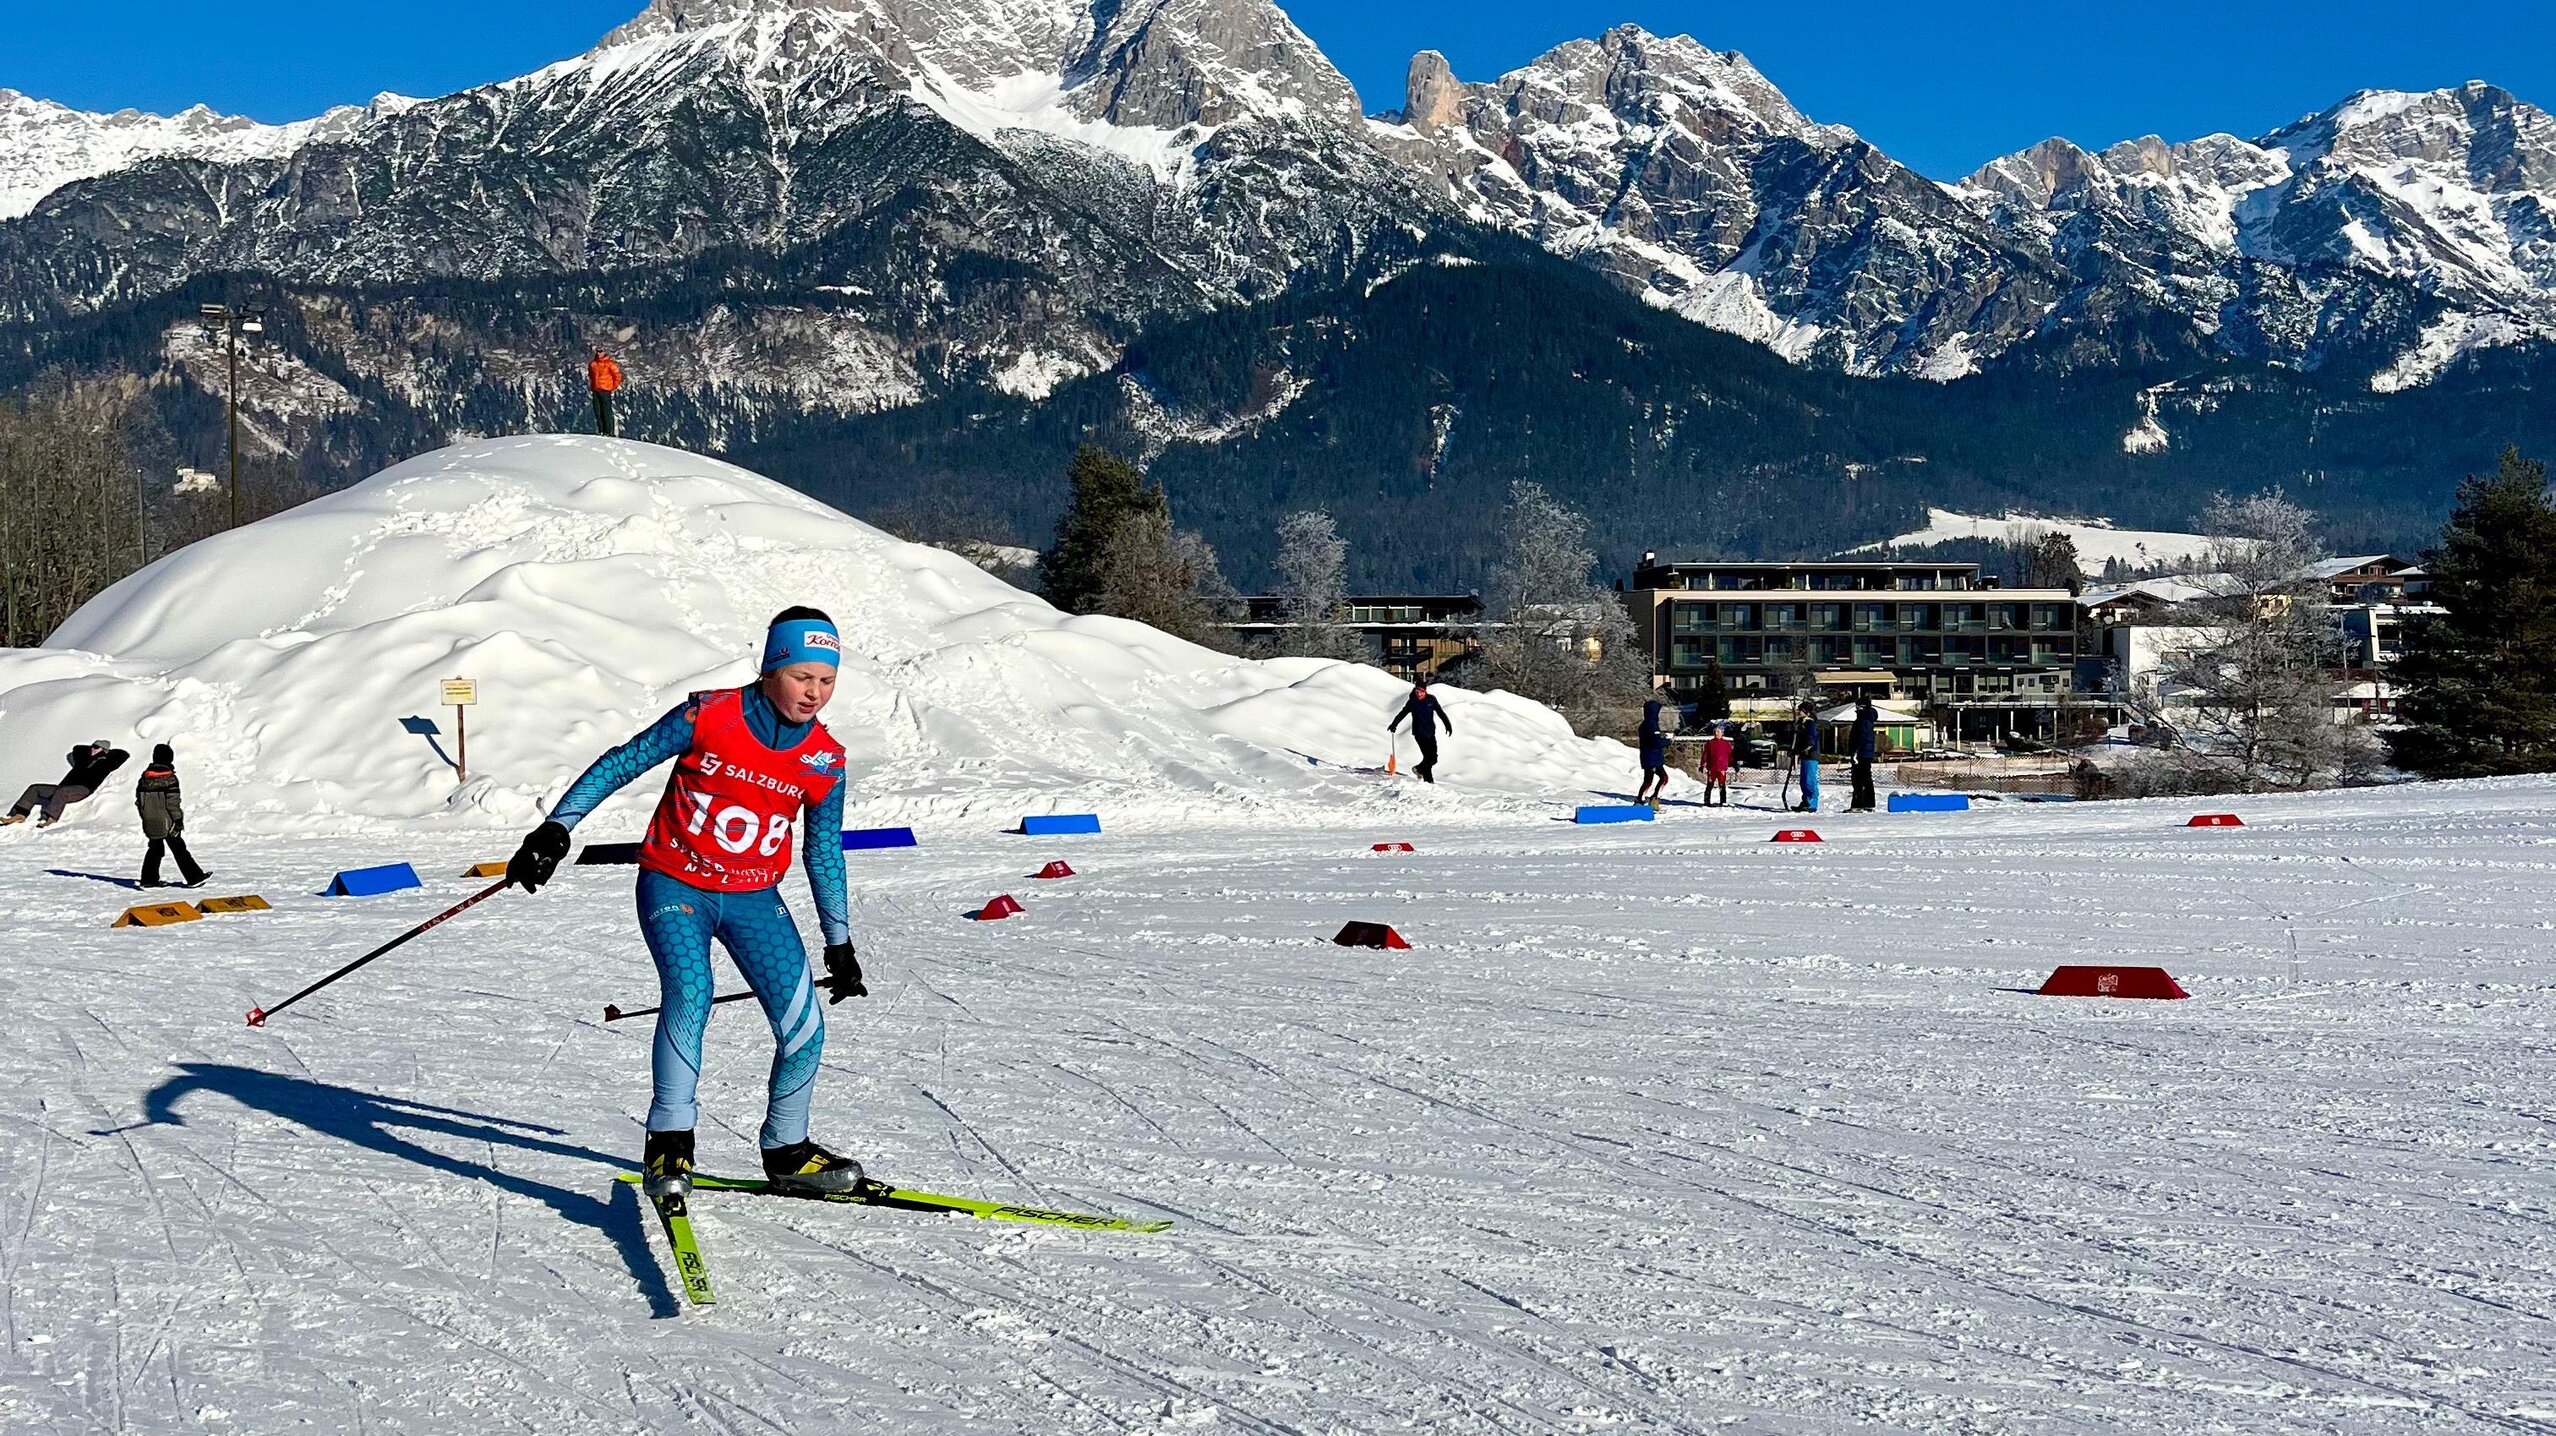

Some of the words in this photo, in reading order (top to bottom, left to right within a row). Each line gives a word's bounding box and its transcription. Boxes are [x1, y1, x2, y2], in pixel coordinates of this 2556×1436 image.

[687, 791, 790, 857] 108
[823, 1193, 868, 1203] FISCHER
[993, 1206, 1116, 1227] FISCHER
